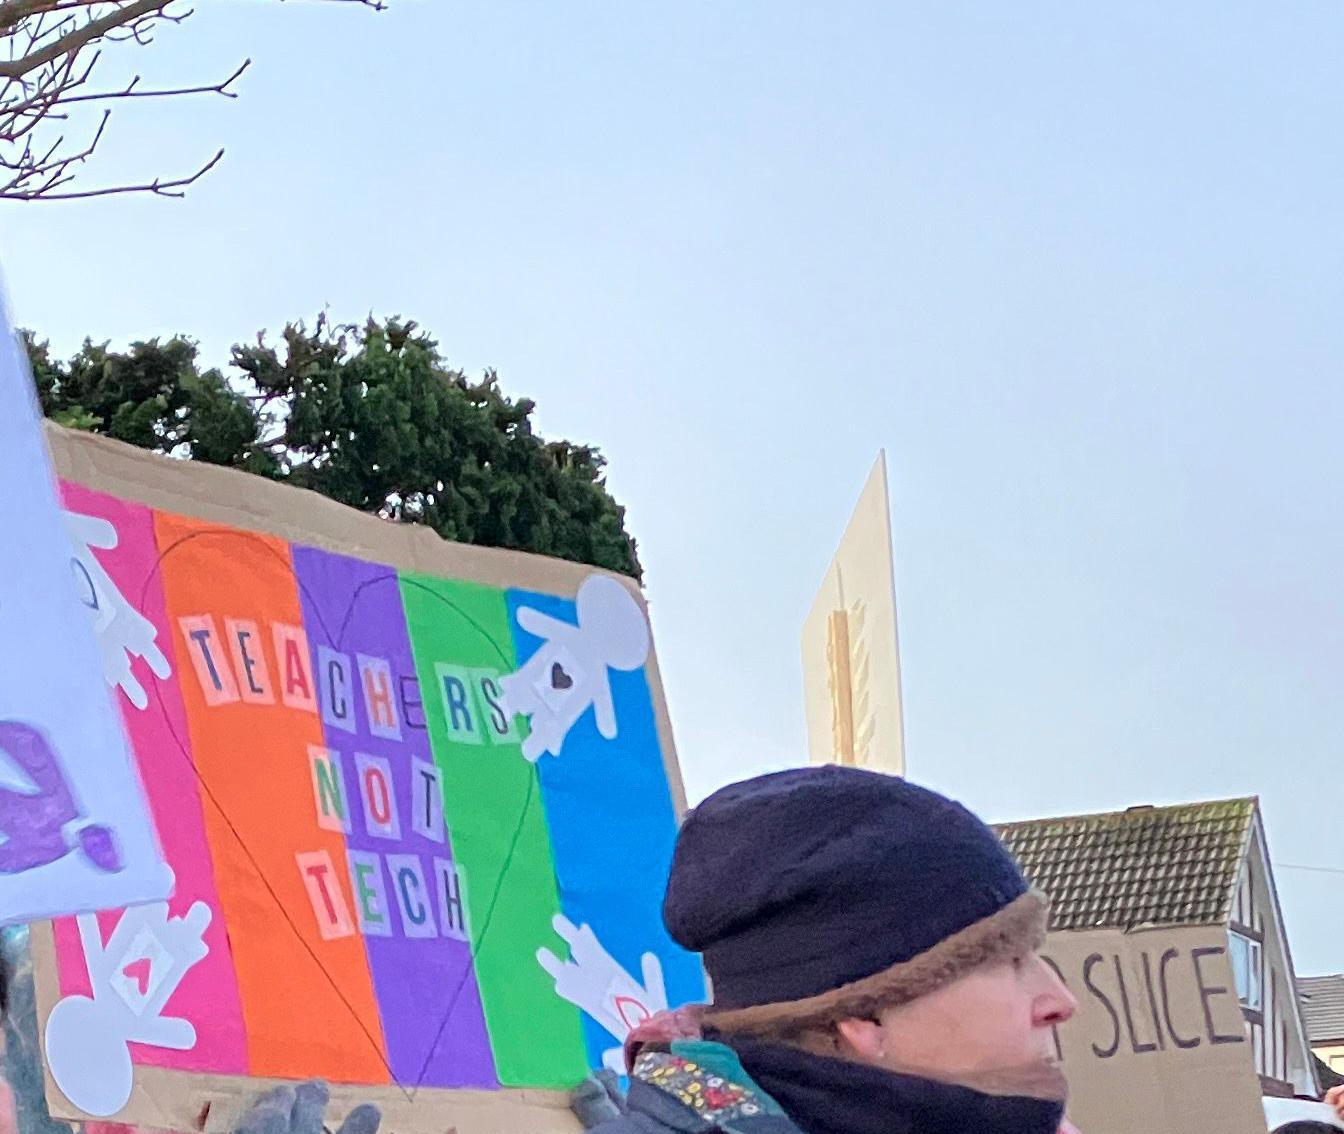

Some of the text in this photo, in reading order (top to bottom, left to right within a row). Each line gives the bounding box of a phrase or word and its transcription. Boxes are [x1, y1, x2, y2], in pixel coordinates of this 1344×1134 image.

[190, 628, 509, 735] TEACHERS
[314, 757, 436, 829] NOT
[306, 864, 465, 933] TECH
[1083, 947, 1244, 1058] SLICE
